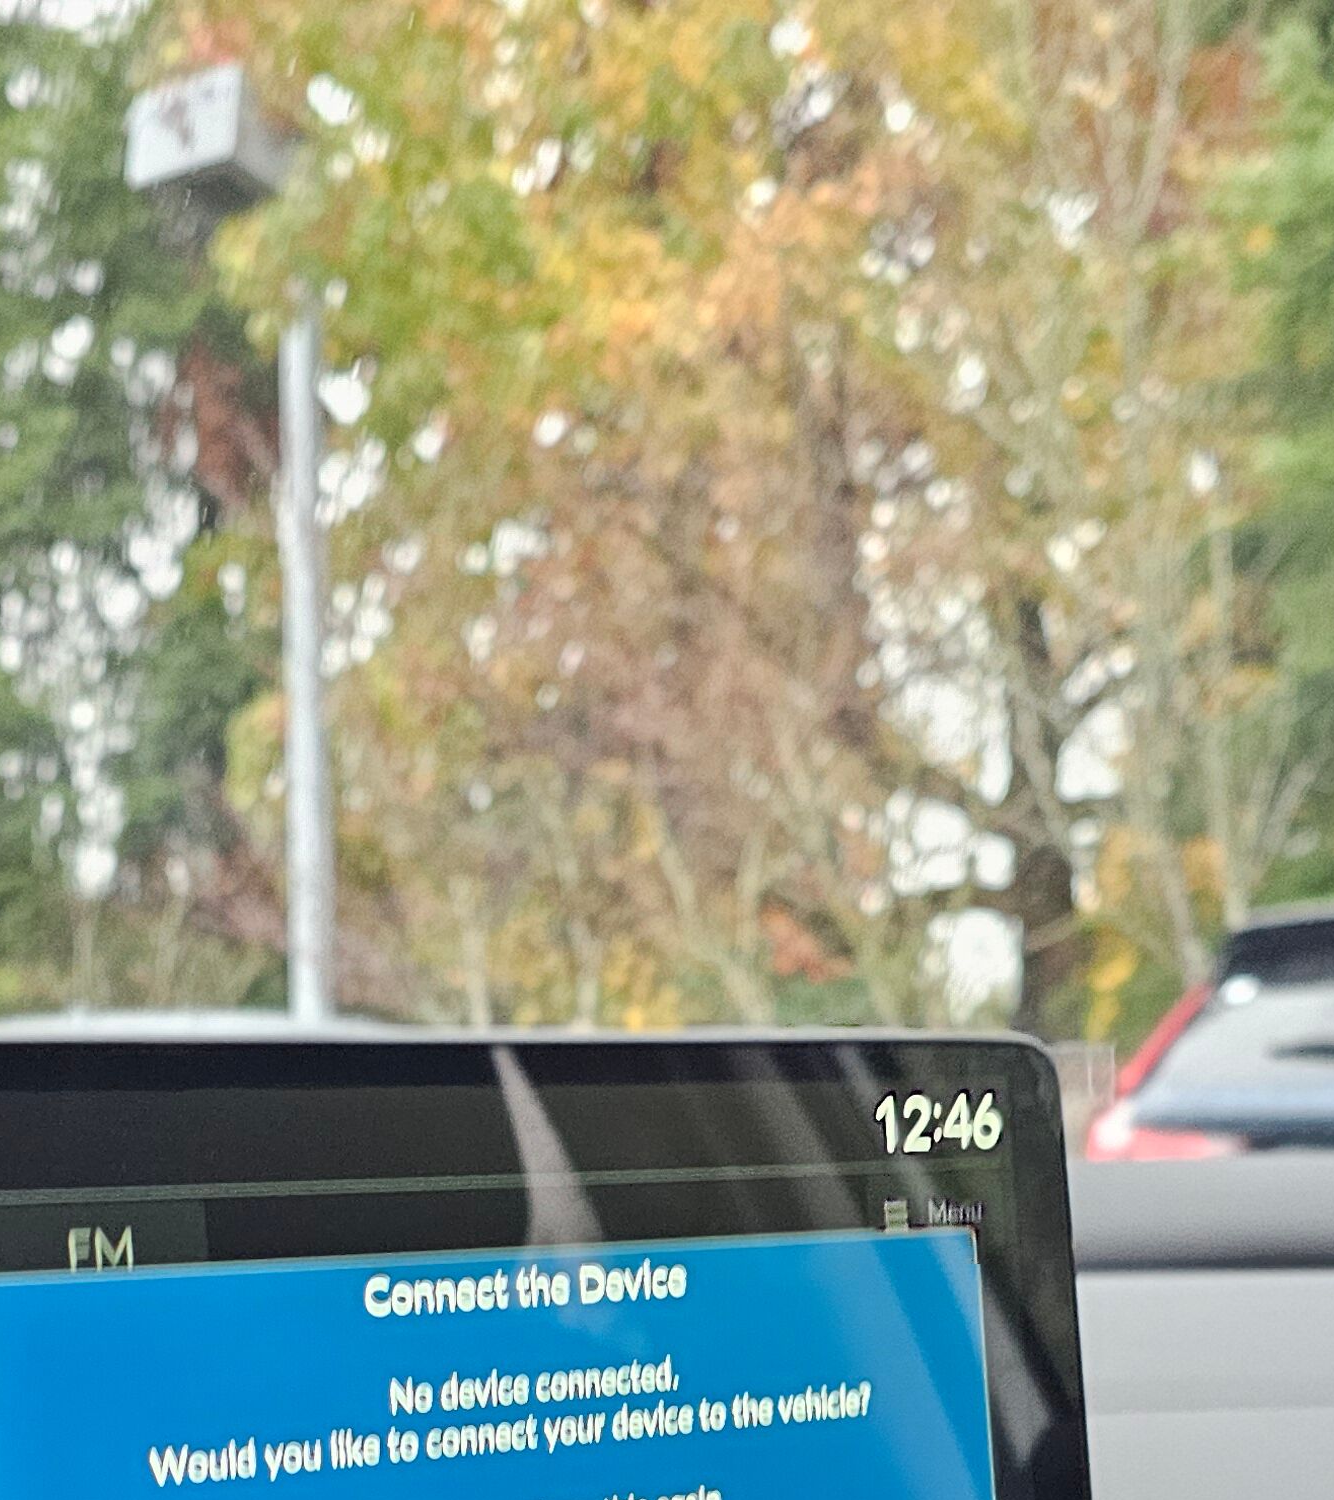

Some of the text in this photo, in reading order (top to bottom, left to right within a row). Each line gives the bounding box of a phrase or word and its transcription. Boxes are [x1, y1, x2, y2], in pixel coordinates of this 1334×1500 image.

[875, 1092, 1003, 1154] 12:46
[68, 1226, 134, 1273] FM
[364, 1257, 688, 1318] Connect the Device
[389, 1375, 433, 1417] No
[440, 1368, 530, 1411] device
[148, 1380, 871, 1487] Would you like to connect your device to the vehicle?
